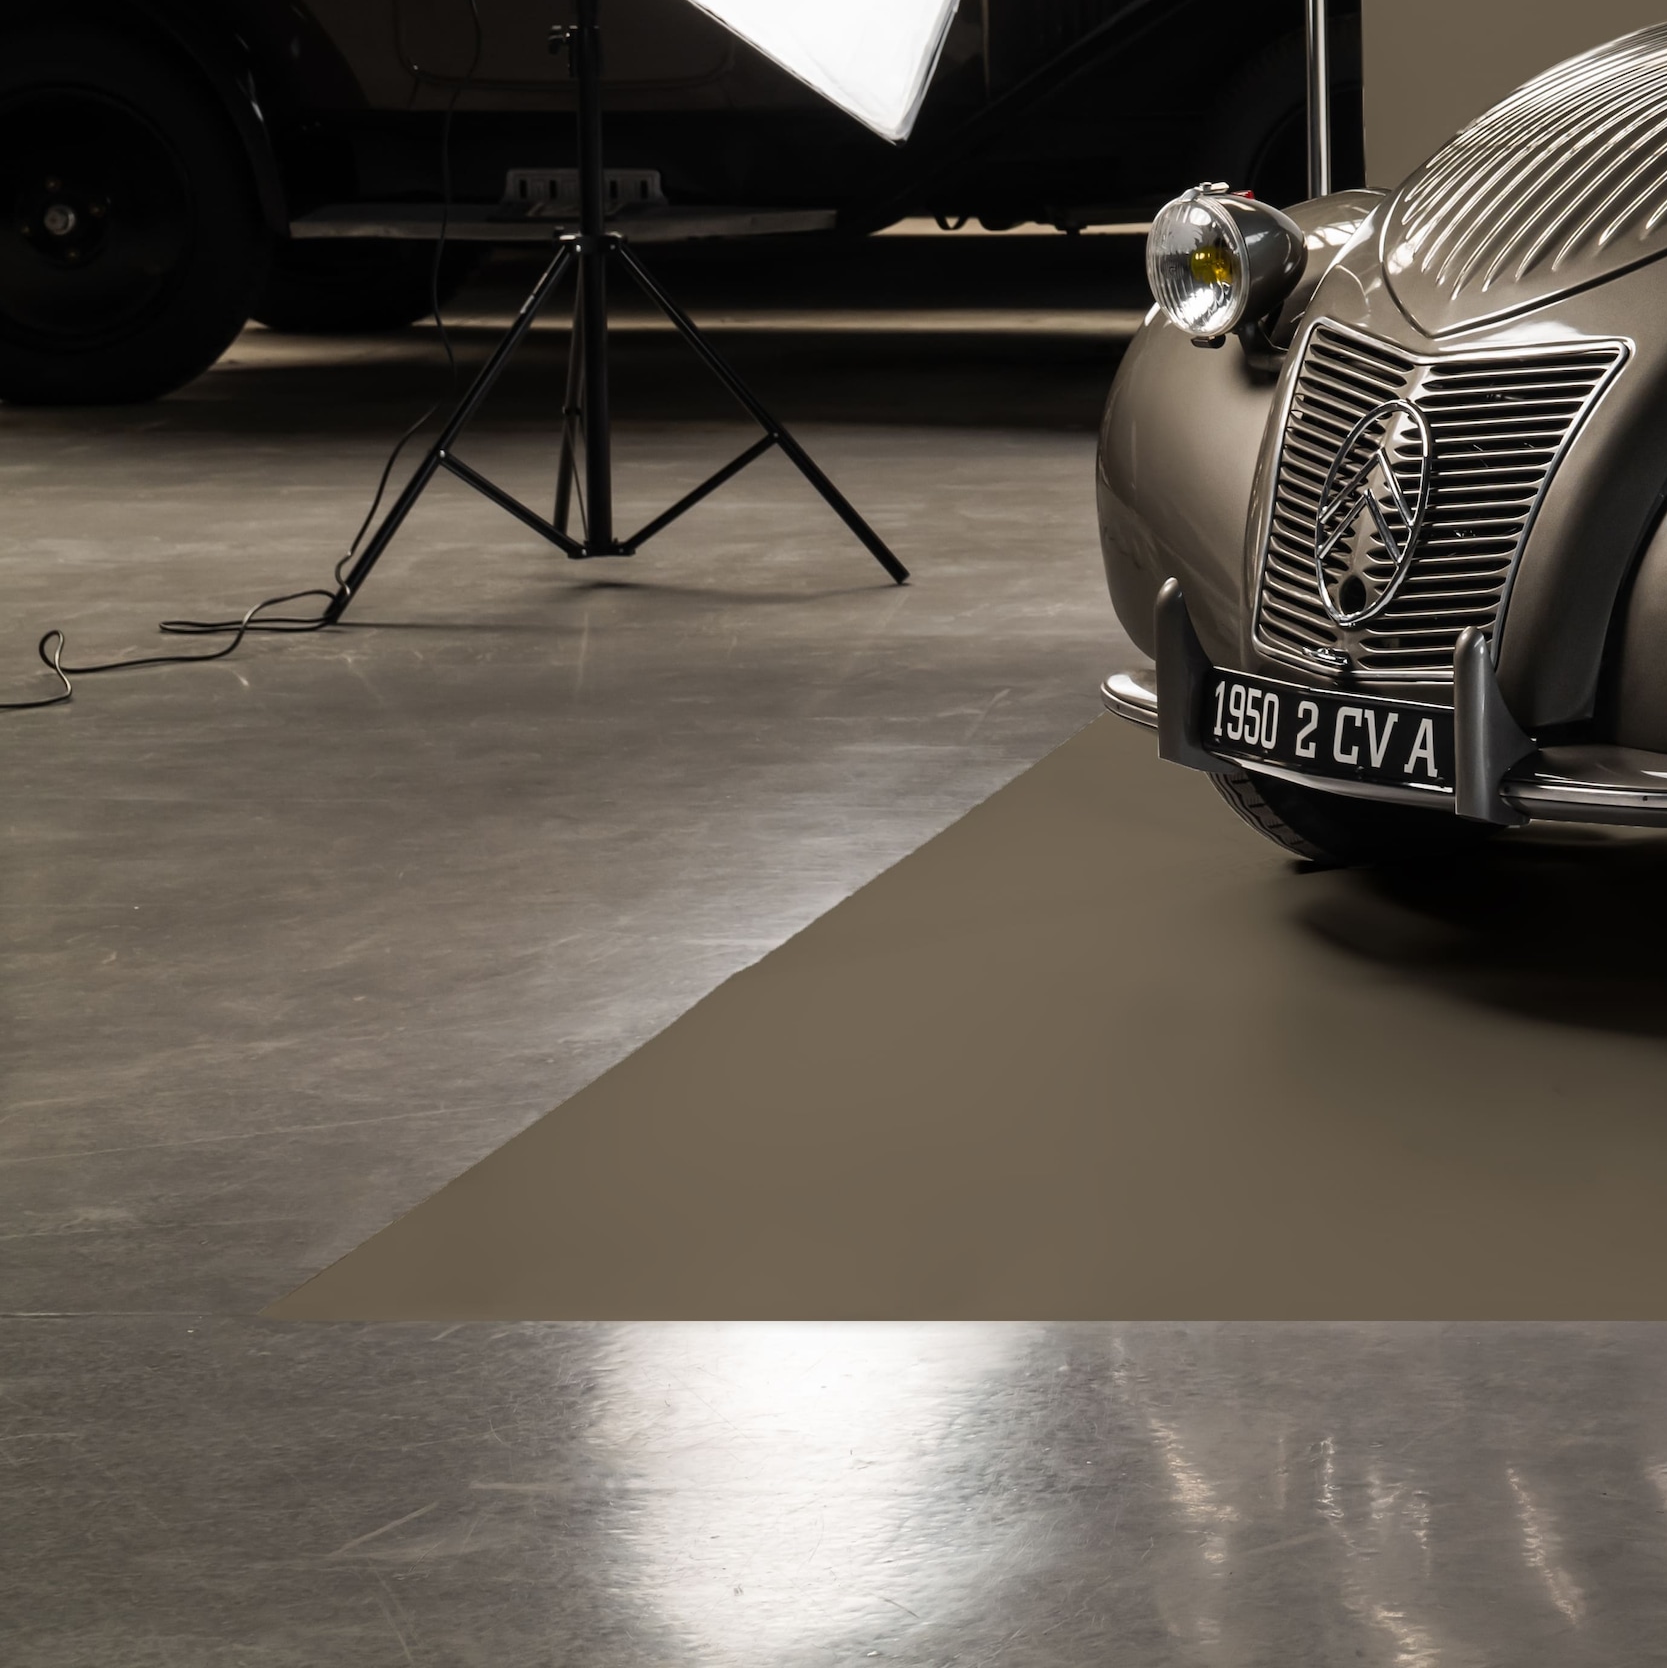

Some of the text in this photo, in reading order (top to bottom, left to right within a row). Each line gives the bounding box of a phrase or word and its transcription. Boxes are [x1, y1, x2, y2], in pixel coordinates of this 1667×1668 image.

[1213, 679, 1438, 778] 1950 2 CV A
